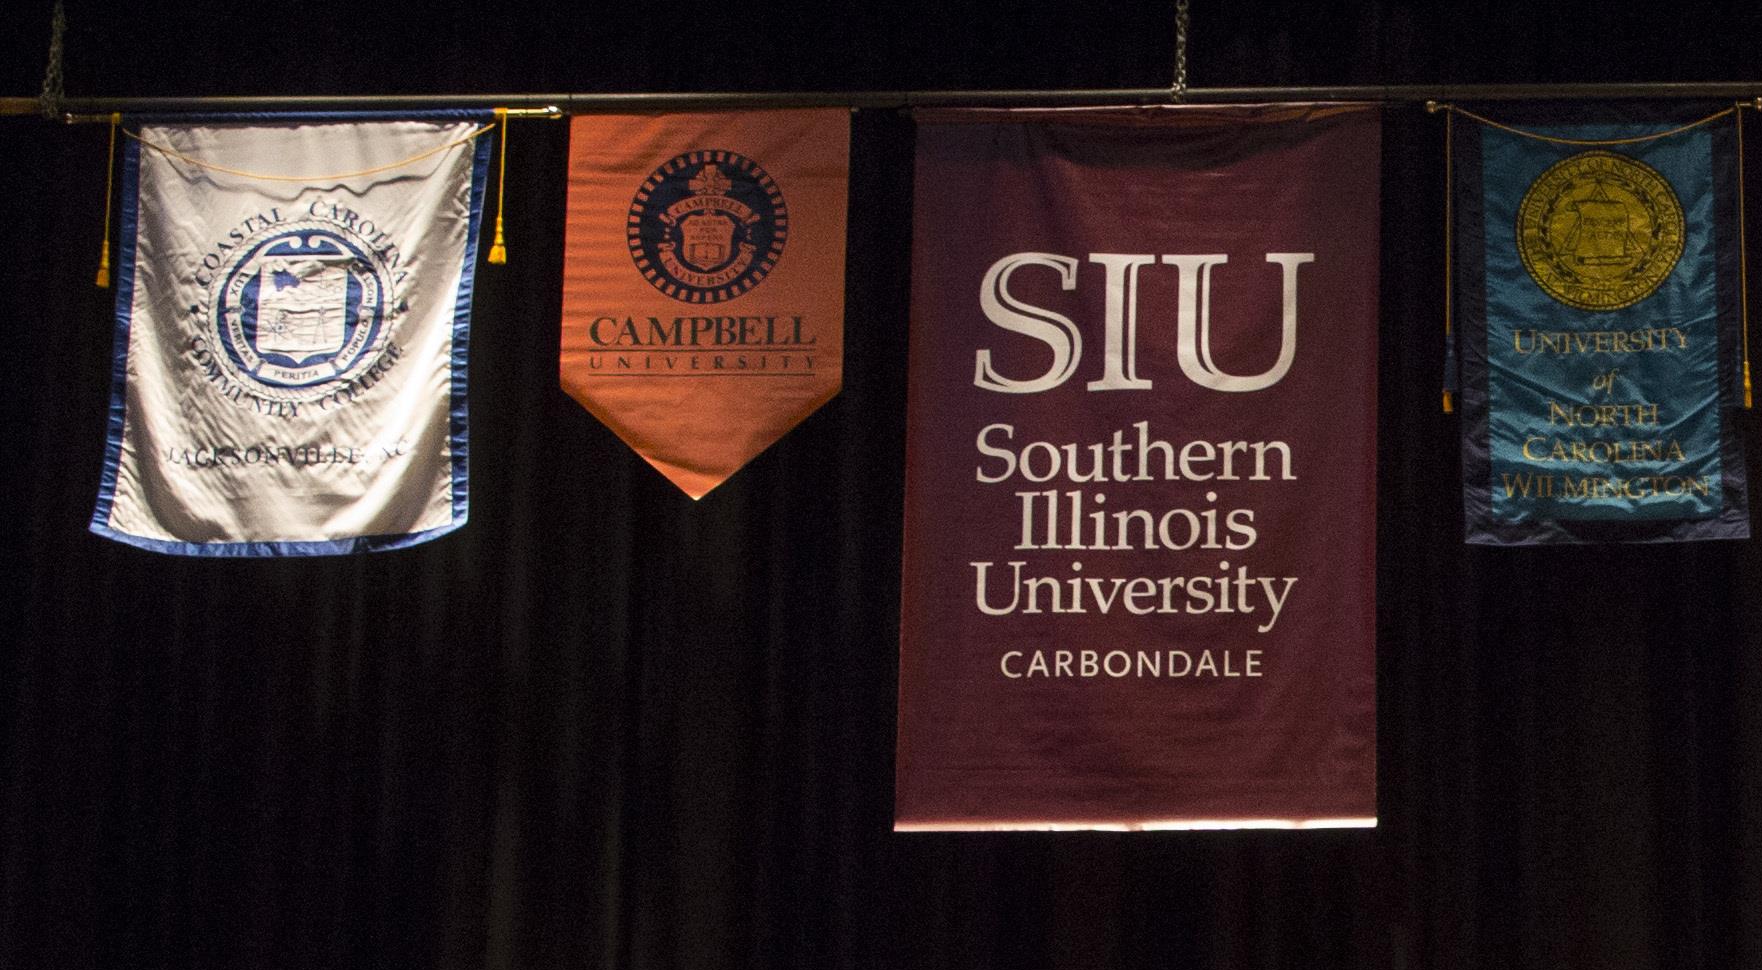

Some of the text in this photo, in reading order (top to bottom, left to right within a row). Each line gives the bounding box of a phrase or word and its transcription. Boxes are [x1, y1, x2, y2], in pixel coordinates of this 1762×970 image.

[195, 201, 408, 287] COASTAL CAROLINA
[588, 316, 817, 346] CAMPBELL
[974, 252, 1315, 394] SIU
[1512, 327, 1690, 354] UNIVERSITY
[191, 335, 404, 417] COMMUNITY COLLEGE
[273, 369, 320, 380] PERITIA
[589, 356, 816, 370] UNIVERSITY
[1592, 367, 1619, 395] of
[1547, 399, 1660, 427] NORTH
[975, 420, 1297, 484] Southern
[1522, 435, 1687, 463] CAROLINA
[1013, 489, 1258, 551] Illinois
[969, 560, 1299, 632] University
[1000, 650, 1263, 678] CARBONDALE
